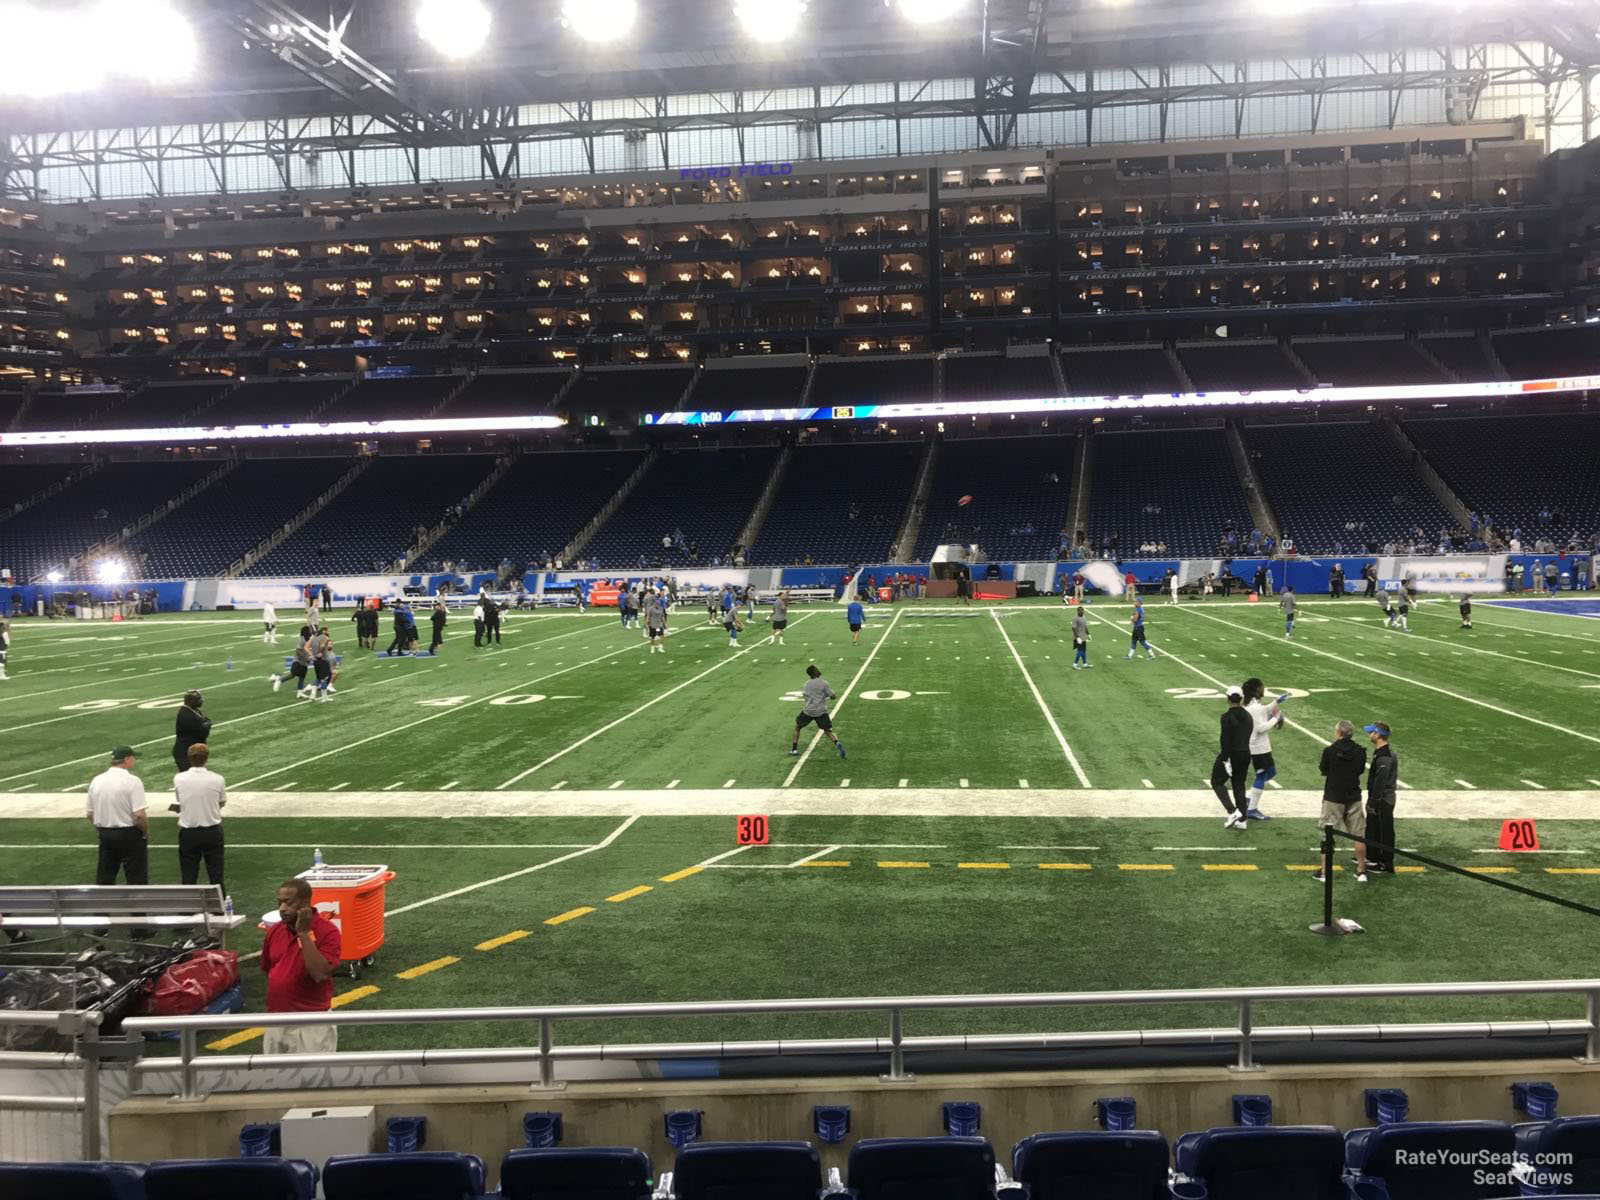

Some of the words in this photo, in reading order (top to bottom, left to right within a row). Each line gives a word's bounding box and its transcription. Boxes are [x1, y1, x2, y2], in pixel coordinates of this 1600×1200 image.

[680, 166, 731, 180] FORD
[737, 162, 793, 177] FIELD
[1086, 273, 1118, 281] CHARLIE
[1121, 271, 1157, 279] SANDERS
[740, 816, 764, 842] 30
[1508, 821, 1535, 849] 20
